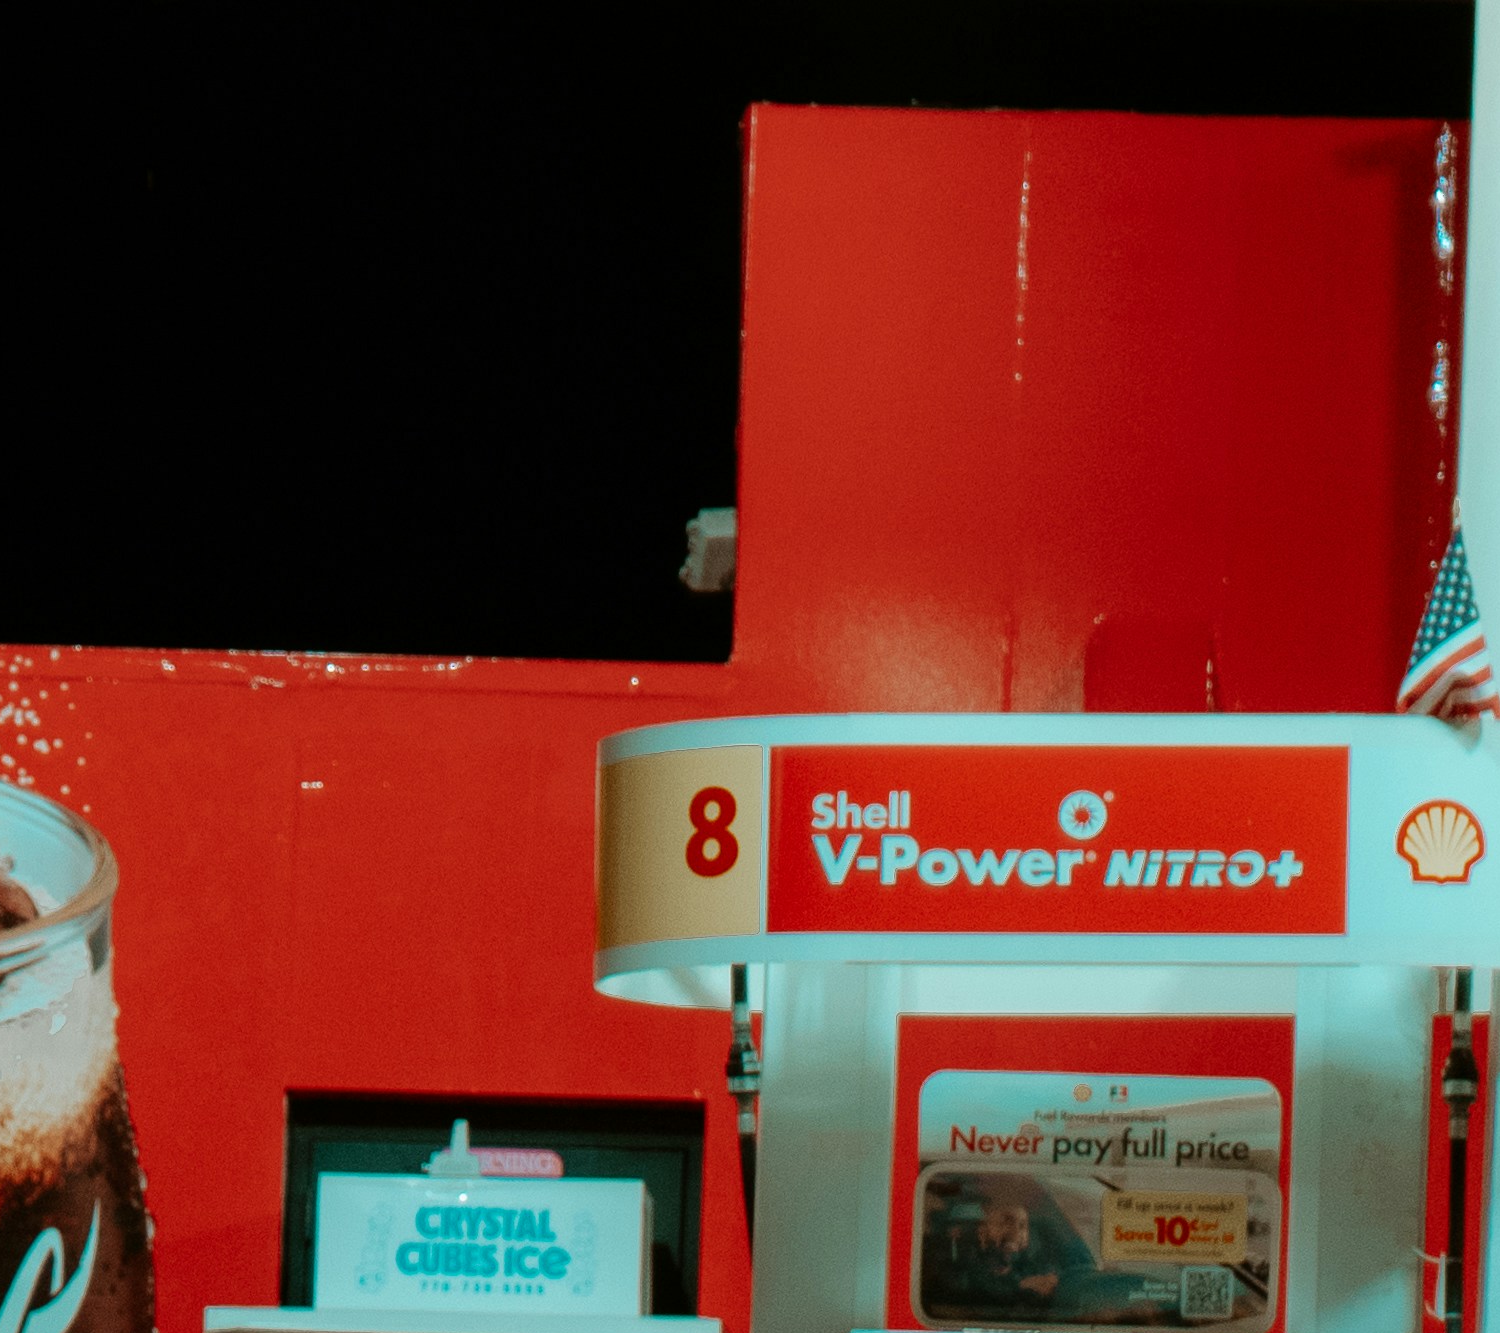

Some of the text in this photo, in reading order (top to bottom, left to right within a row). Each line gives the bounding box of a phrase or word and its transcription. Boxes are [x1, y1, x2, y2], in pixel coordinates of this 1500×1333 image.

[811, 790, 911, 829] Shell
[685, 786, 739, 878] 8
[811, 834, 1085, 886] V-Power
[951, 1126, 1249, 1166] Never pay full price
[415, 1206, 557, 1242] CRYSTAL
[395, 1243, 498, 1278] CUBES
